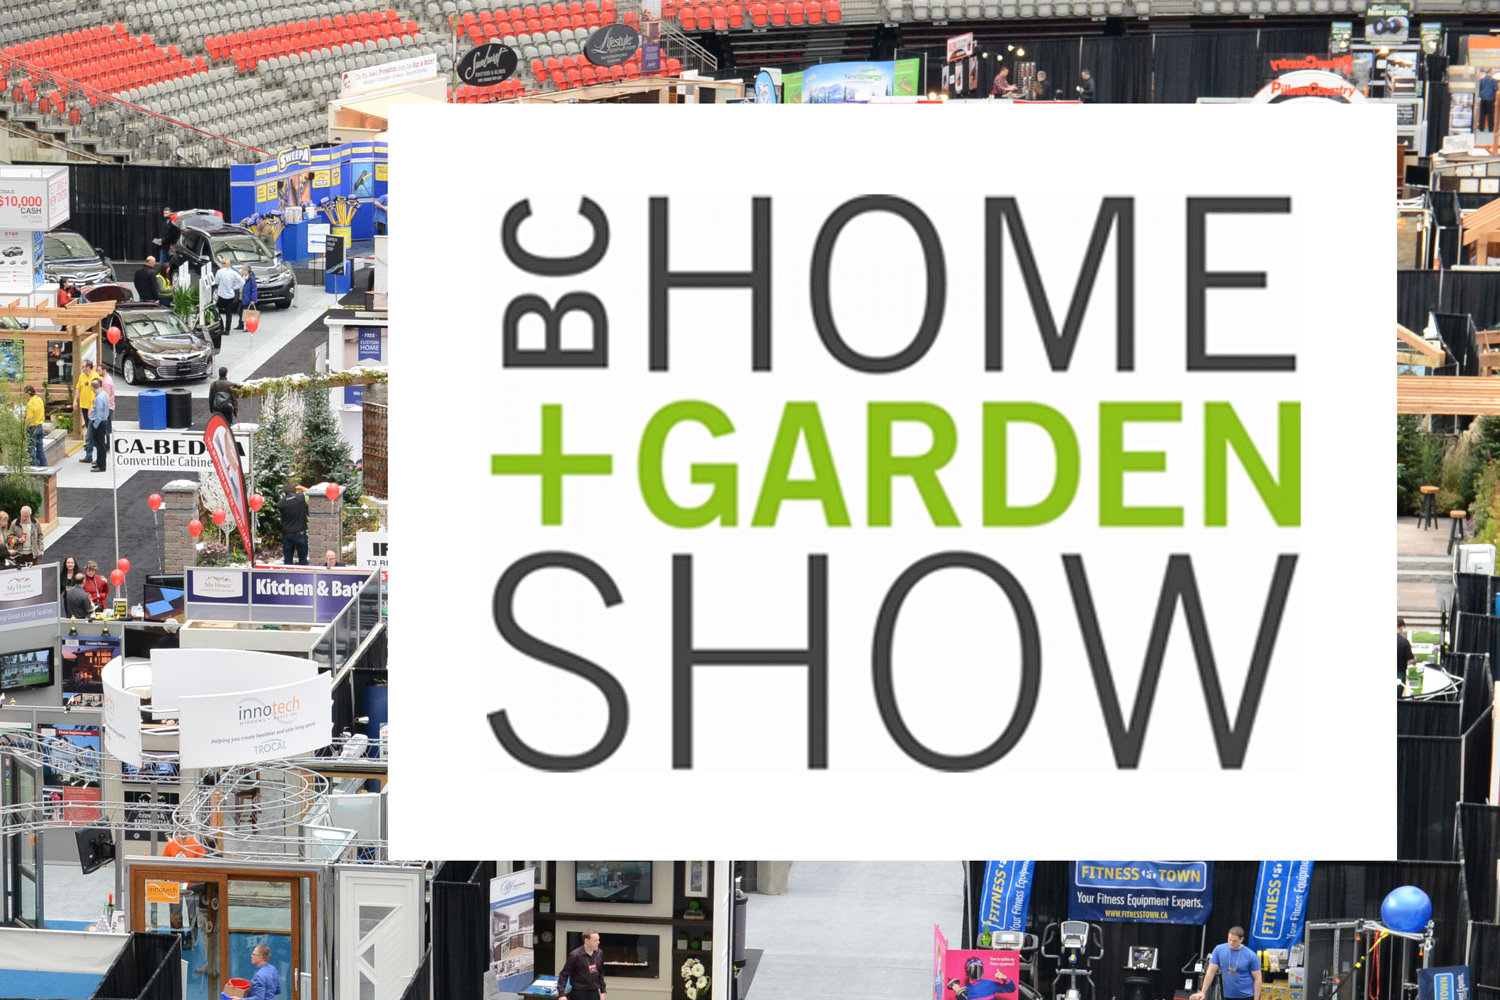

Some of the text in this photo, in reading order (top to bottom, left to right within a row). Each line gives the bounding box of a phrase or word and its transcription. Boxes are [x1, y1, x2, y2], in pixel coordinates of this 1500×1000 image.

[280, 148, 309, 169] SWEEPA
[116, 455, 176, 467] Convertible
[7, 584, 16, 592] My
[215, 581, 231, 589] House
[256, 578, 329, 597] Kitchen &
[7, 610, 21, 621] Great
[21, 610, 36, 620] Living
[36, 608, 54, 619] Spaces
[238, 695, 300, 721] innotech
[256, 730, 276, 738] healthier
[254, 742, 288, 755] TROCAL
[1081, 866, 1201, 883] FITNESS TOWN
[988, 869, 1007, 923] FITNESS
[1011, 889, 1025, 911] Fitness
[1076, 891, 1204, 909] Your Fitness Equipment Experts.
[1104, 909, 1169, 920] WWW.FITNESSTOWN.CA
[1261, 878, 1282, 935] FITNESS
[1440, 975, 1449, 1000] TOWN
